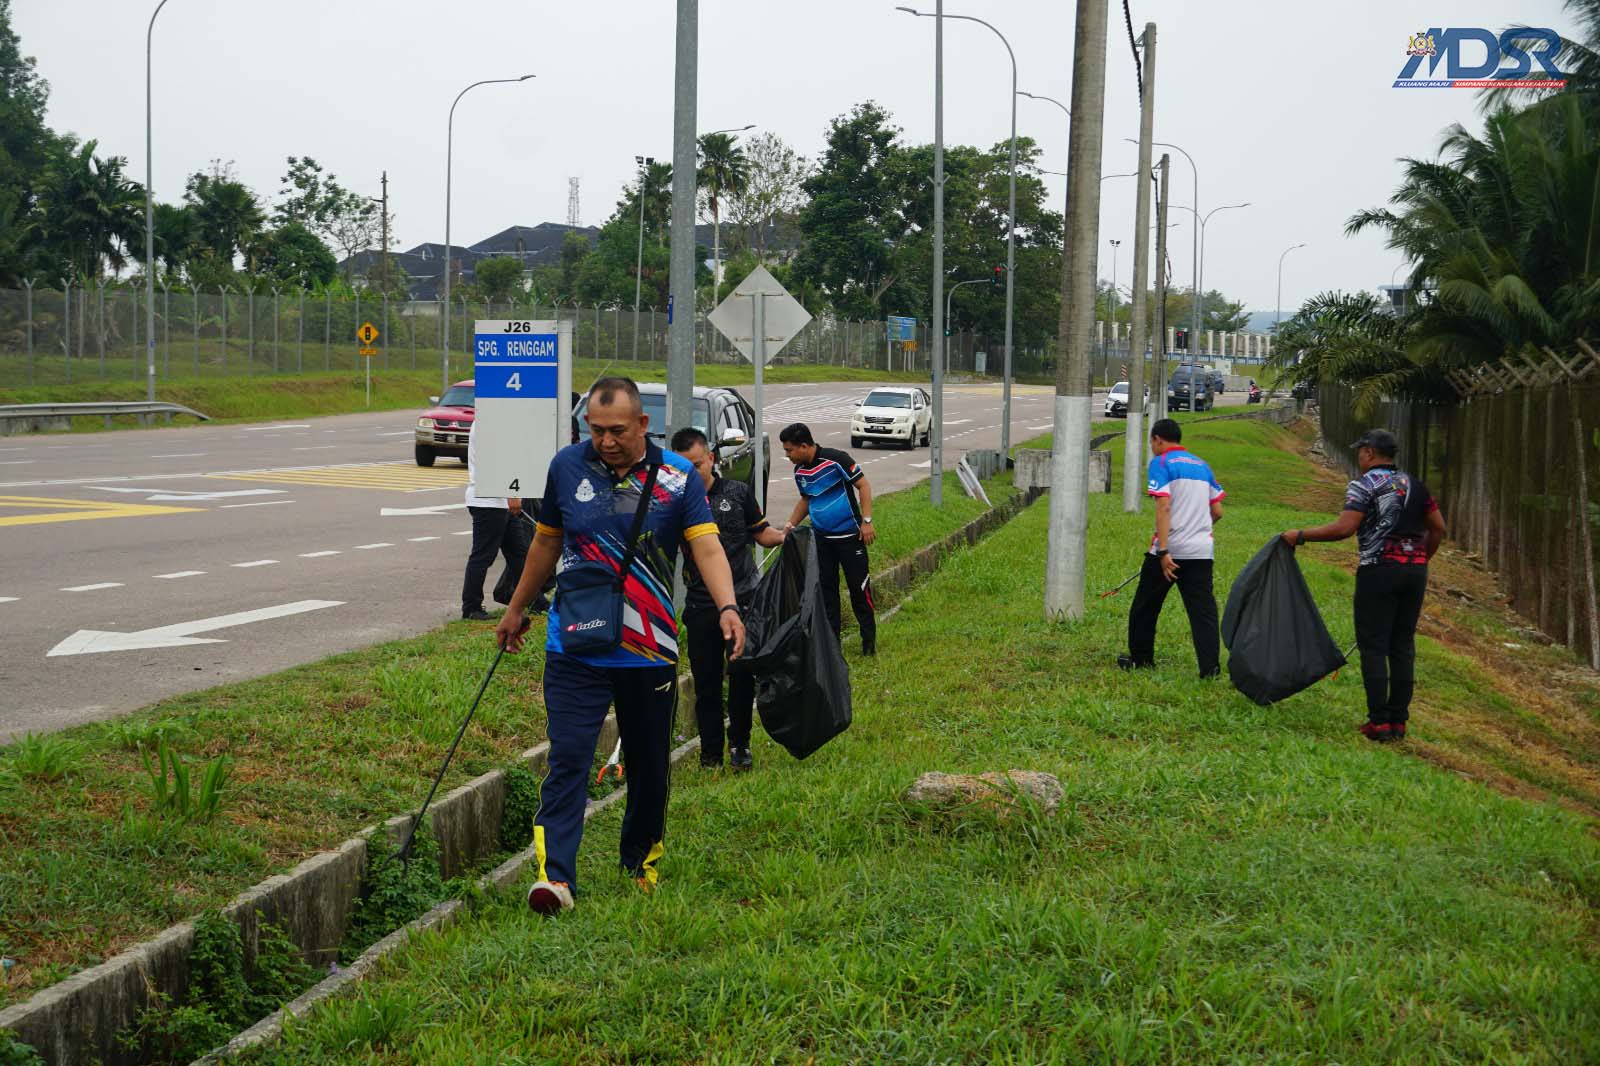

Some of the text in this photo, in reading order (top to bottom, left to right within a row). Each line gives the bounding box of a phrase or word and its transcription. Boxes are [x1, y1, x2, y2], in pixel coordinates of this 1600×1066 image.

[503, 321, 531, 333] J26
[477, 340, 555, 357] SPG. RENGGAM
[505, 372, 523, 391] 4
[508, 478, 521, 492] 4
